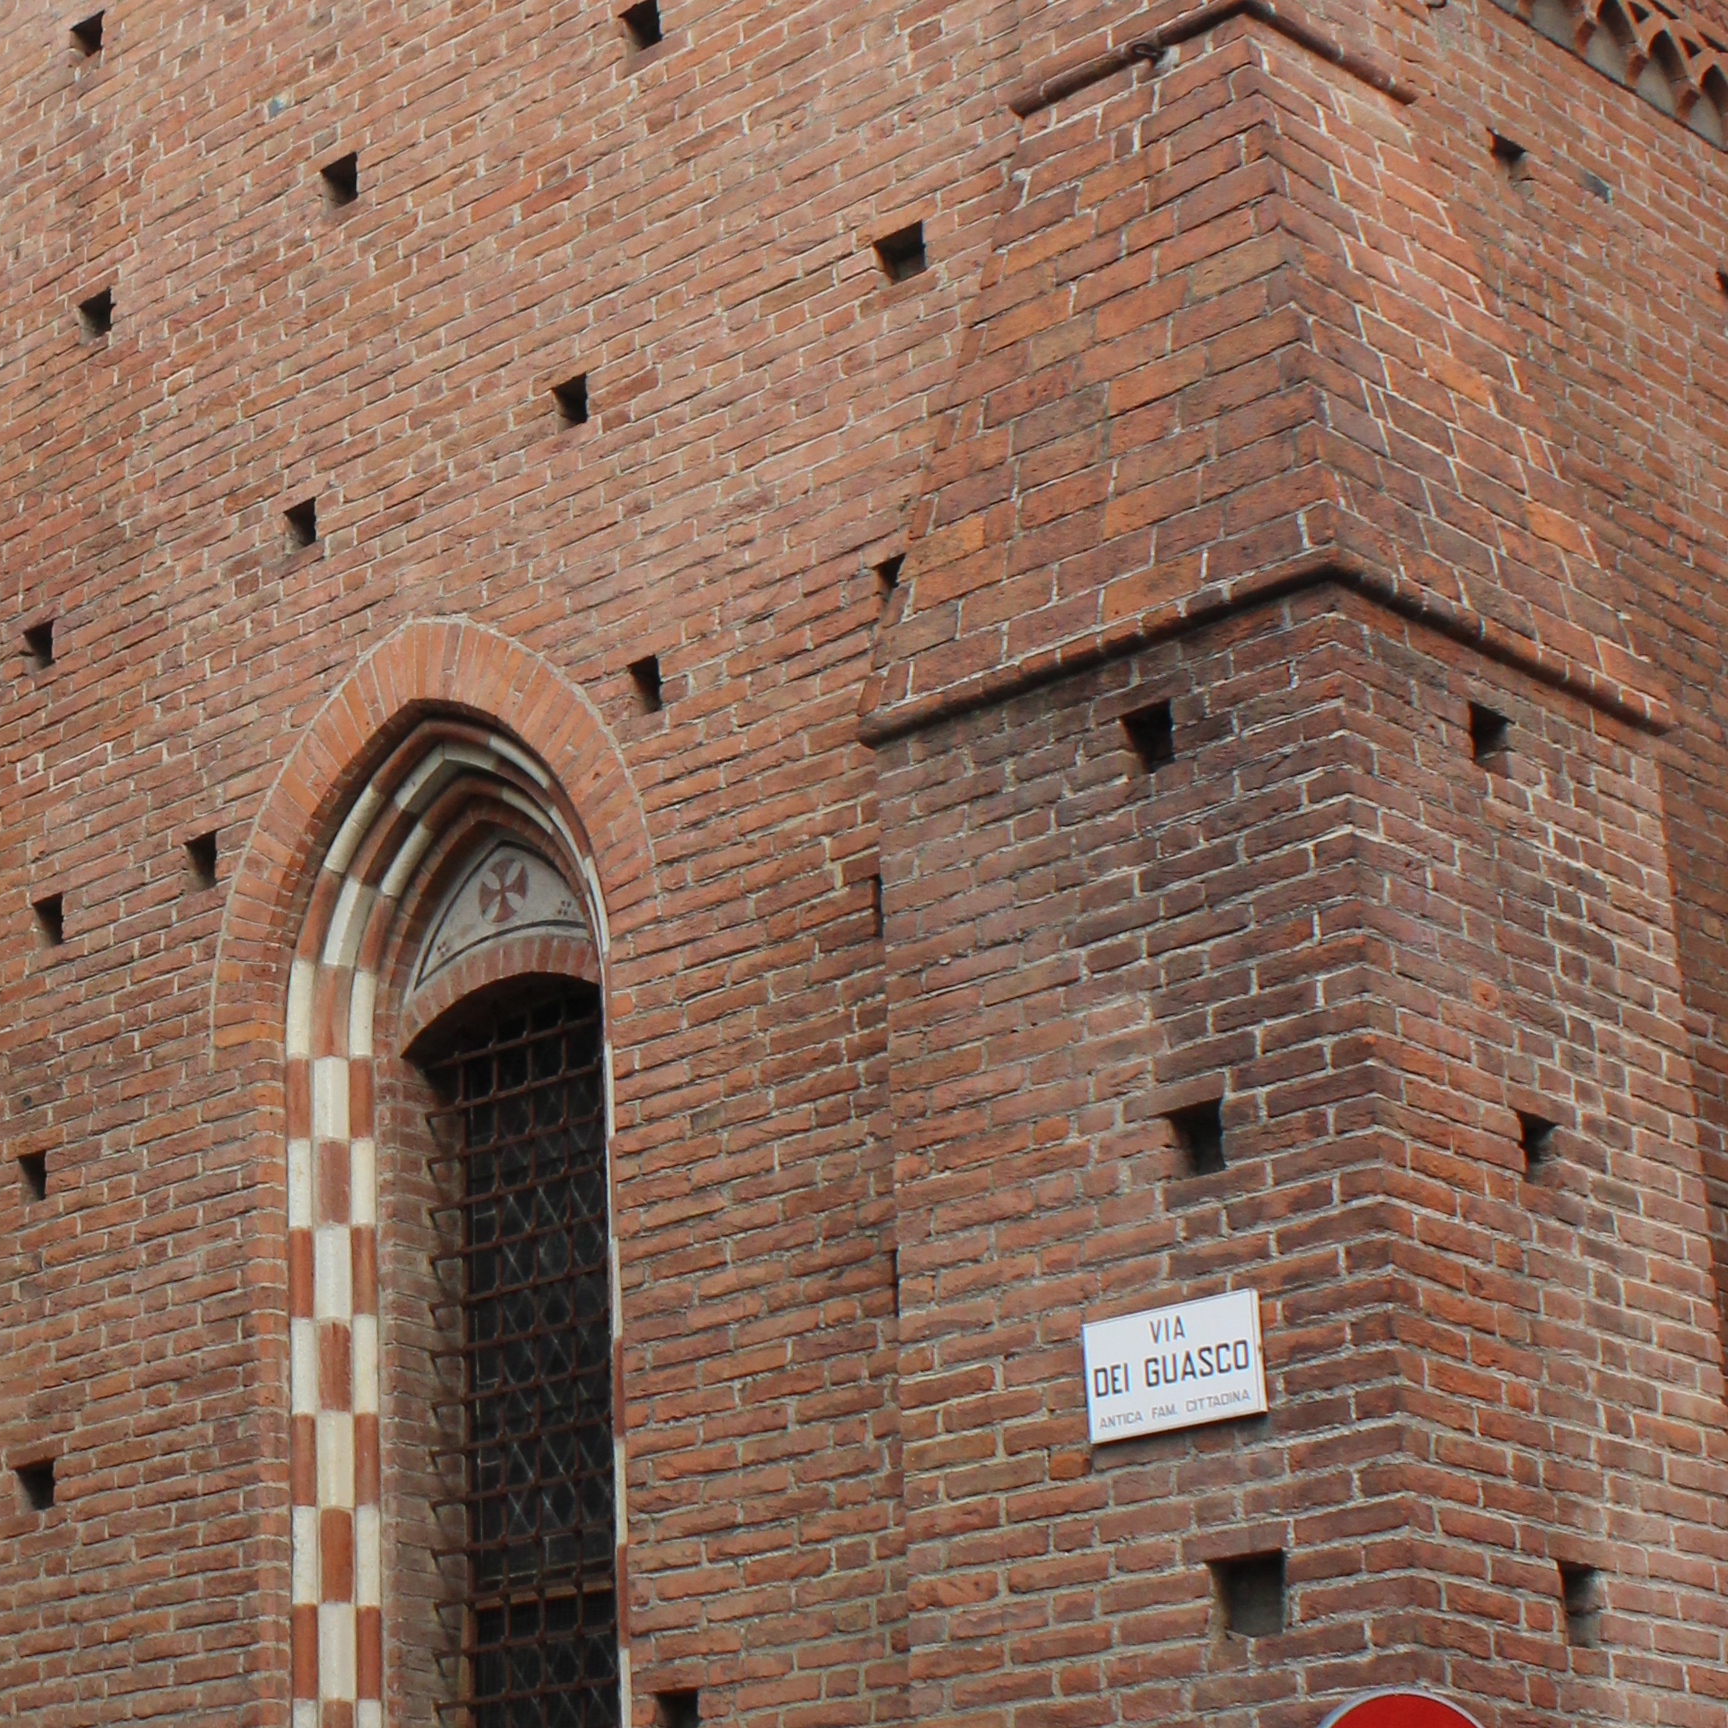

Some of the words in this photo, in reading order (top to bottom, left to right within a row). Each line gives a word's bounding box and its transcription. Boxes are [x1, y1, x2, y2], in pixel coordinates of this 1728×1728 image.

[1149, 1315, 1186, 1344] VIA
[1093, 1362, 1130, 1398] DEI
[1144, 1339, 1250, 1388] GUASCO
[1099, 1410, 1144, 1429] ANTICA
[1185, 1388, 1251, 1413] CITTADINA
